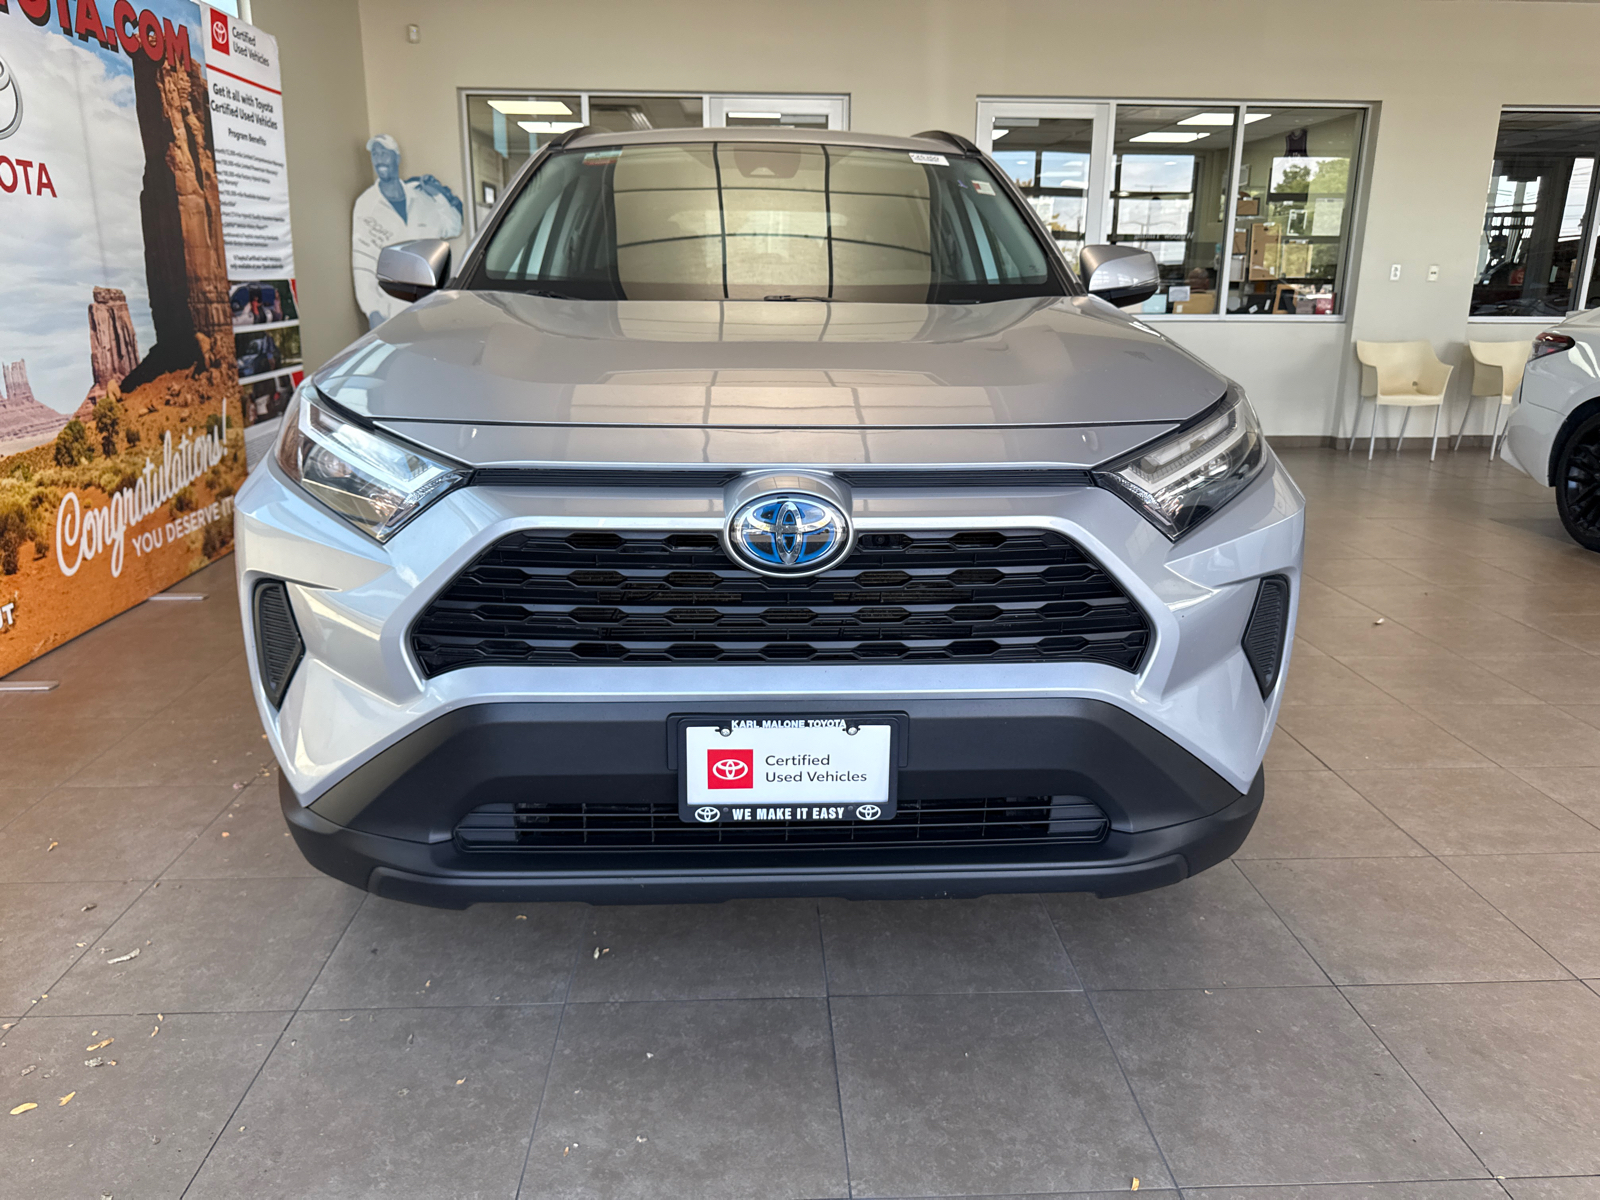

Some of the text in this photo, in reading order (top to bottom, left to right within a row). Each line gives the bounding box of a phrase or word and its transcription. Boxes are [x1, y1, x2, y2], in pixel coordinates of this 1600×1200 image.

[232, 26, 256, 47] Certified
[232, 41, 270, 67] Used Vehicles
[212, 82, 274, 113] Get it all with Toyota
[210, 99, 278, 130] Certified Used Vehicles
[228, 127, 267, 146] Program Benefits
[56, 397, 227, 578] Congratulations!
[131, 527, 163, 557] YOU
[165, 501, 221, 543] DESERVE
[731, 718, 847, 729] KARL MALONE TOYOTA
[765, 754, 830, 766] Certified
[765, 770, 867, 783] Used Vehicles
[732, 807, 845, 820] WE MAKE IT EASY
